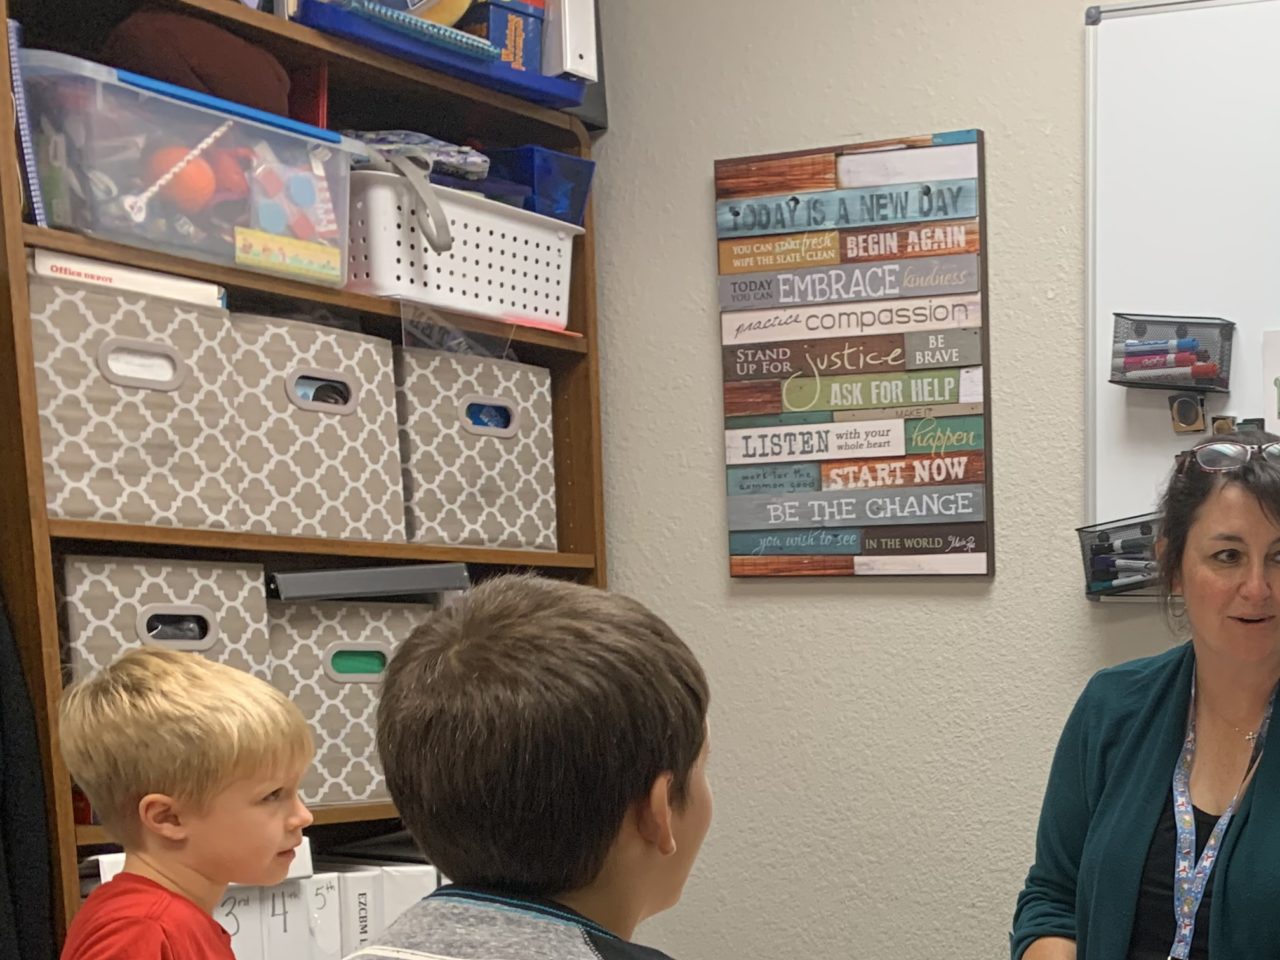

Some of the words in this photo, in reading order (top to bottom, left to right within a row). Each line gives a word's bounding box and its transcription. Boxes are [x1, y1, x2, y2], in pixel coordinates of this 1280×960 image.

[729, 199, 800, 231] TODAY
[806, 197, 826, 227] IS
[835, 197, 850, 225] A
[860, 191, 908, 223] NEW
[919, 186, 963, 218] DAY
[732, 245, 752, 256] YOU
[753, 242, 773, 254] CAN
[774, 239, 801, 253] START
[801, 230, 838, 257] fresh
[846, 231, 898, 258] BEGIN
[906, 225, 966, 253] AGAIN
[732, 256, 755, 268] WIPE
[757, 254, 775, 266] THE
[775, 252, 801, 264] SLATE
[806, 249, 835, 261] CLEAN
[50, 264, 83, 278] Office
[84, 272, 113, 284] DEPOT
[731, 279, 773, 294] TODAY
[777, 264, 900, 303] EMBRACE
[902, 265, 968, 288] kindness
[731, 292, 751, 303] YOU
[753, 290, 774, 301] CAN
[734, 309, 803, 339] practice
[805, 299, 969, 333] compassion
[928, 335, 945, 349] BE
[762, 361, 793, 374] FOR
[915, 349, 960, 365] BRAVE
[736, 347, 791, 362] STAND
[782, 341, 906, 412] justice
[830, 383, 863, 407] ASK
[870, 380, 904, 405] FOR
[910, 377, 955, 403] HELP
[895, 408, 923, 418] MAKE
[741, 429, 831, 458] LISTEN
[835, 428, 861, 441] with
[864, 428, 892, 442] your
[837, 442, 865, 451] whole
[866, 439, 892, 450] heart
[911, 416, 977, 458] happen
[741, 469, 767, 481] work
[829, 461, 907, 490] START
[912, 456, 969, 483] NOW
[739, 481, 785, 491] common
[789, 480, 816, 494] good
[766, 501, 800, 524] BE
[807, 498, 857, 521] THE
[865, 492, 974, 519] CHANGE
[751, 535, 783, 556] you
[785, 529, 820, 547] wish
[819, 530, 832, 546] to
[836, 533, 857, 547] see
[865, 539, 878, 550] IN
[881, 538, 901, 550] THE
[904, 537, 944, 549] WORLD
[357, 892, 369, 937] EZCBM
